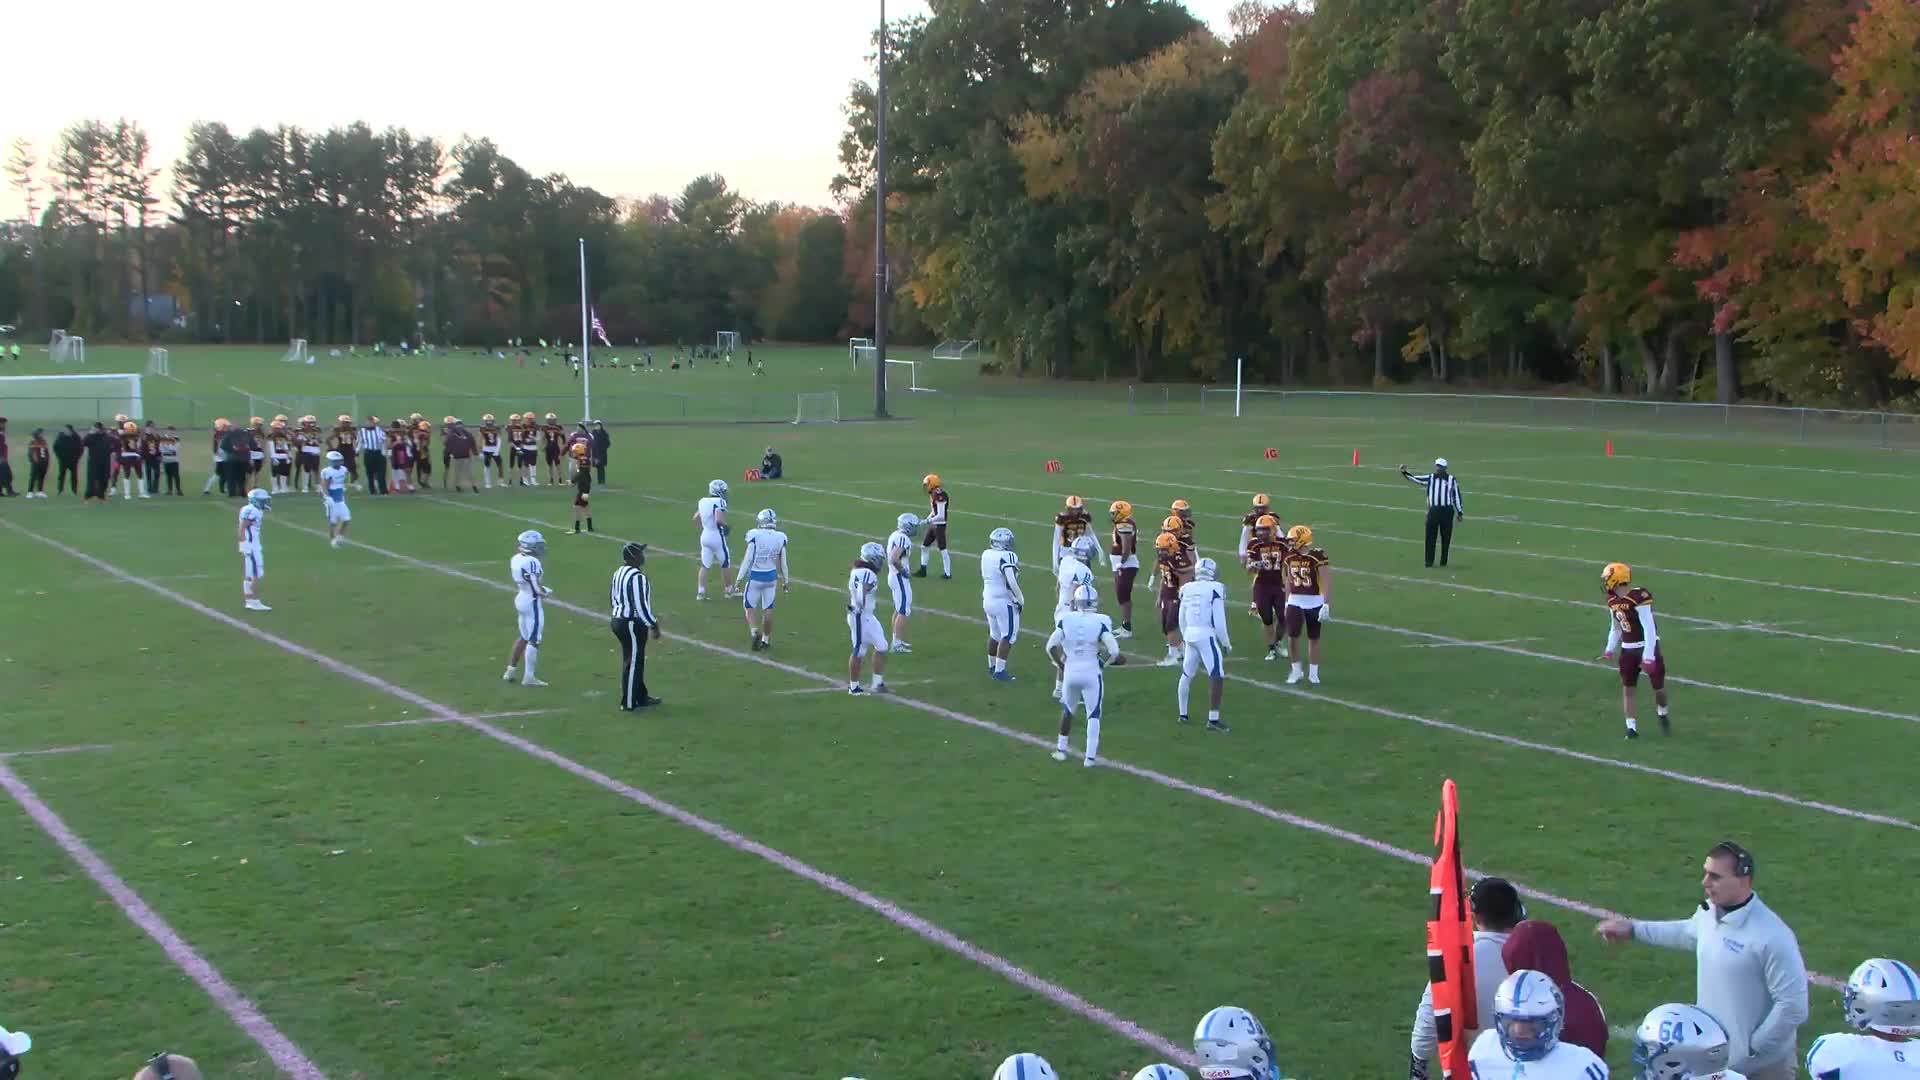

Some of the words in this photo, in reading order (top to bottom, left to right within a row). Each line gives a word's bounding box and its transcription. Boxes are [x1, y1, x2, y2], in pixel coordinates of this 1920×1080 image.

[1261, 551, 1281, 571] 57
[1658, 1020, 1683, 1042] 64
[1894, 1050, 1906, 1063] G
